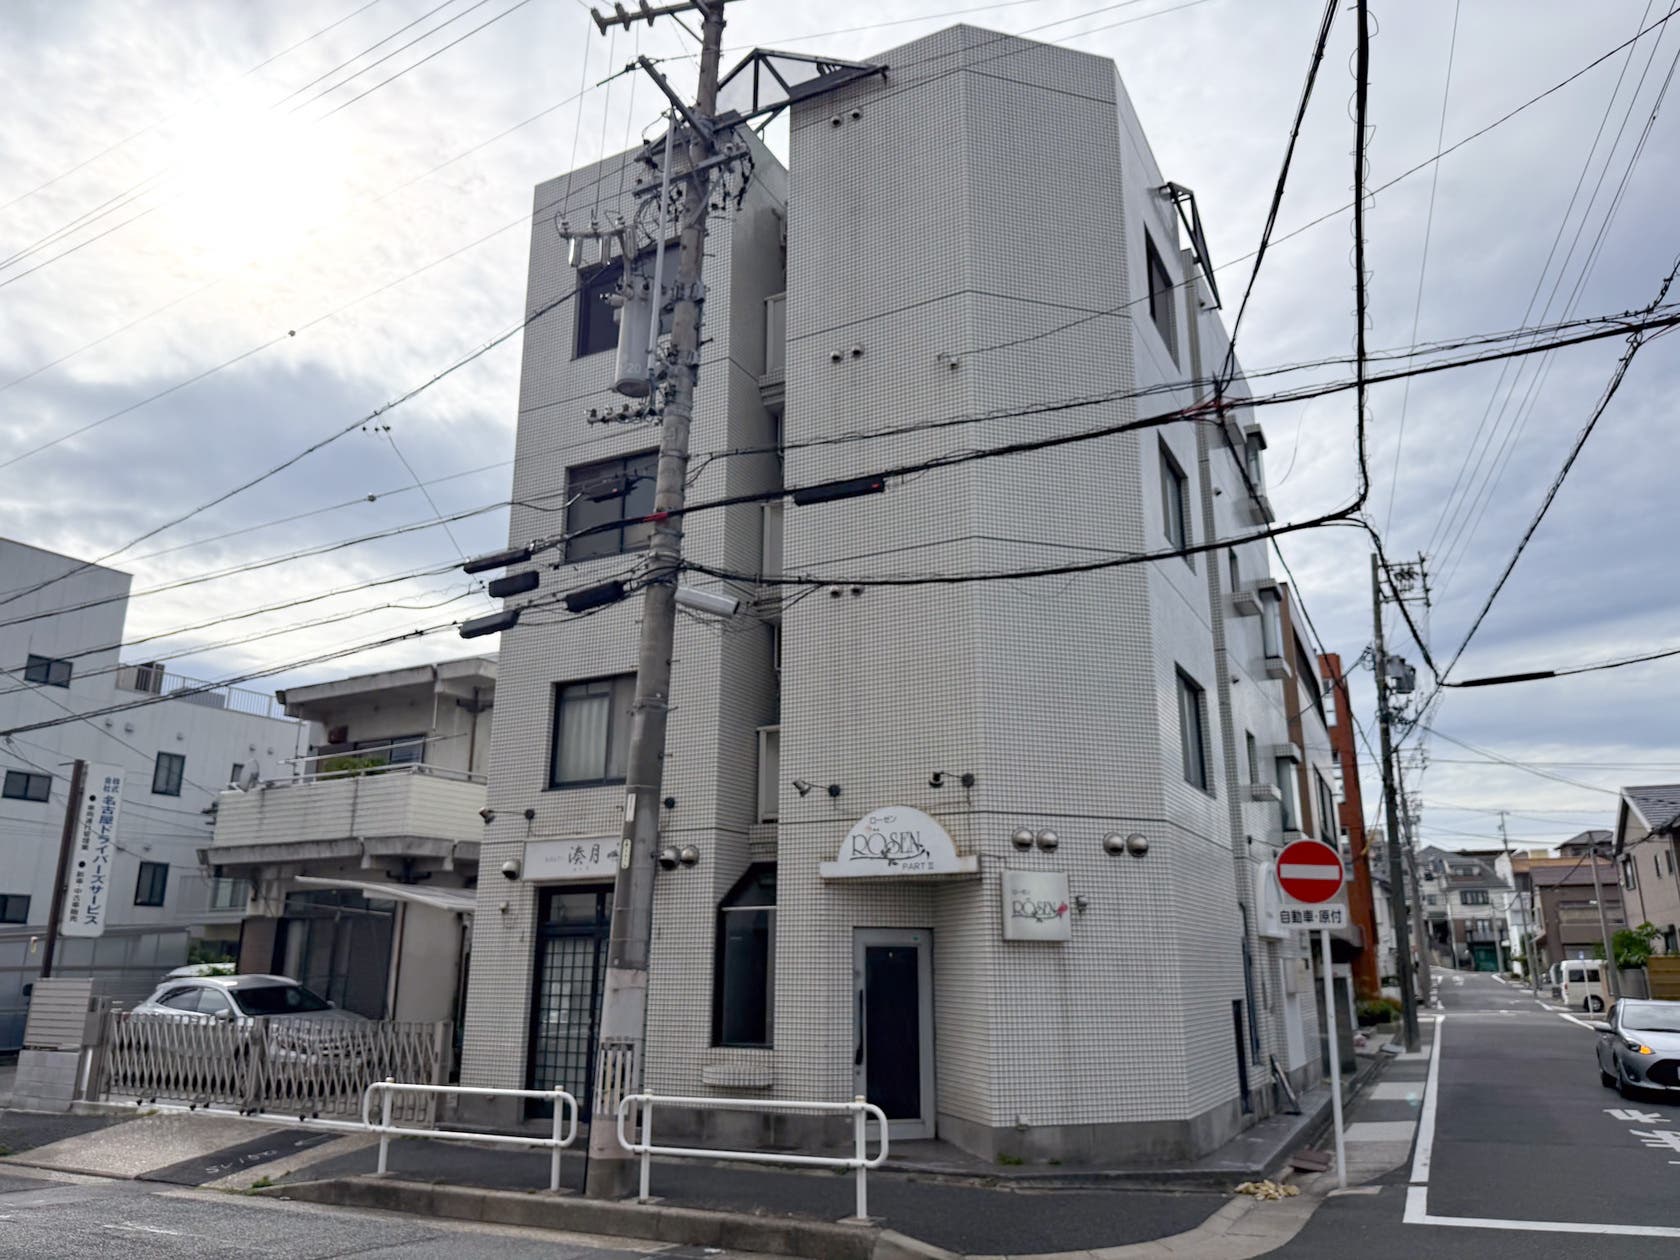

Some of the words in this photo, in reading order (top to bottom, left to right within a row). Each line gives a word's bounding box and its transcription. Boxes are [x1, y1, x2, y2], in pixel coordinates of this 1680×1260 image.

[869, 815, 897, 824] ローゼン
[902, 862, 925, 871] PART
[1279, 910, 1342, 924] 自動車・原付
